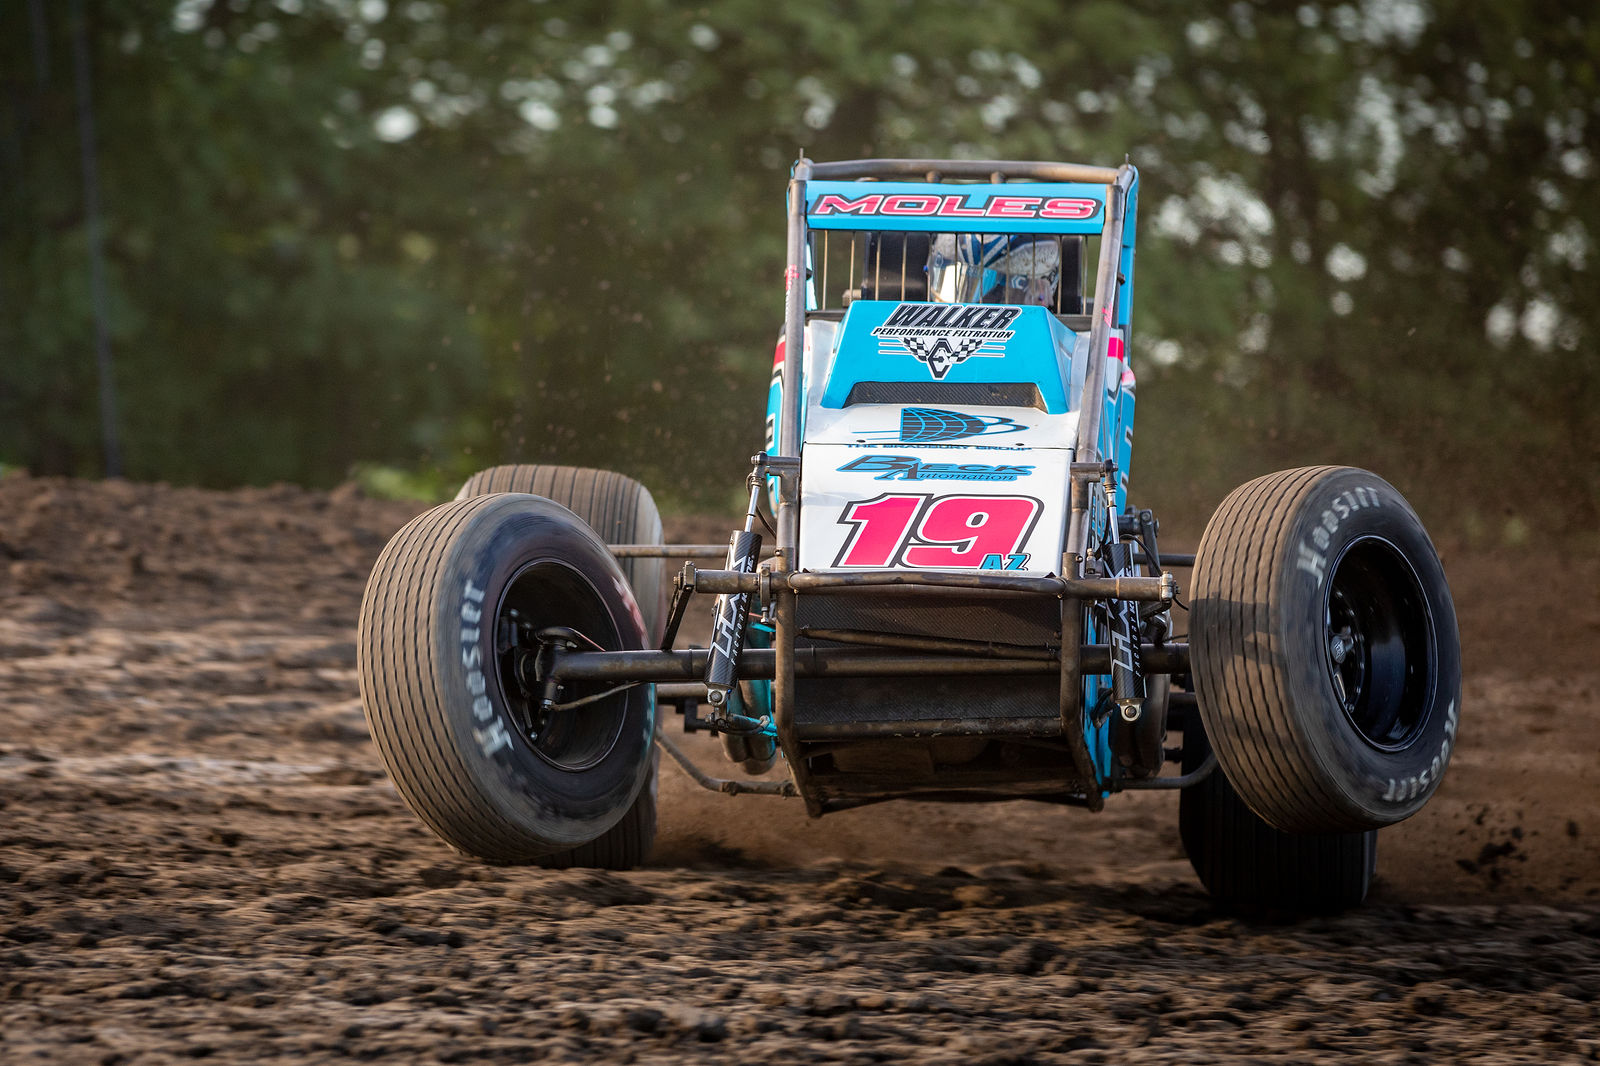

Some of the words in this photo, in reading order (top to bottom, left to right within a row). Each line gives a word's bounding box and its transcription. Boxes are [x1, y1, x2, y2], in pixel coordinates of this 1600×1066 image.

[809, 194, 1101, 219] MOLES
[884, 303, 1021, 330] WALKER
[872, 327, 952, 338] PERFORMANCE
[952, 330, 1015, 339] FILTRATION
[875, 462, 1017, 481] Automation
[831, 493, 1044, 569] 19
[980, 553, 1032, 571] AZ
[730, 604, 746, 666] FACTORY
[1130, 615, 1142, 678] FACTORY
